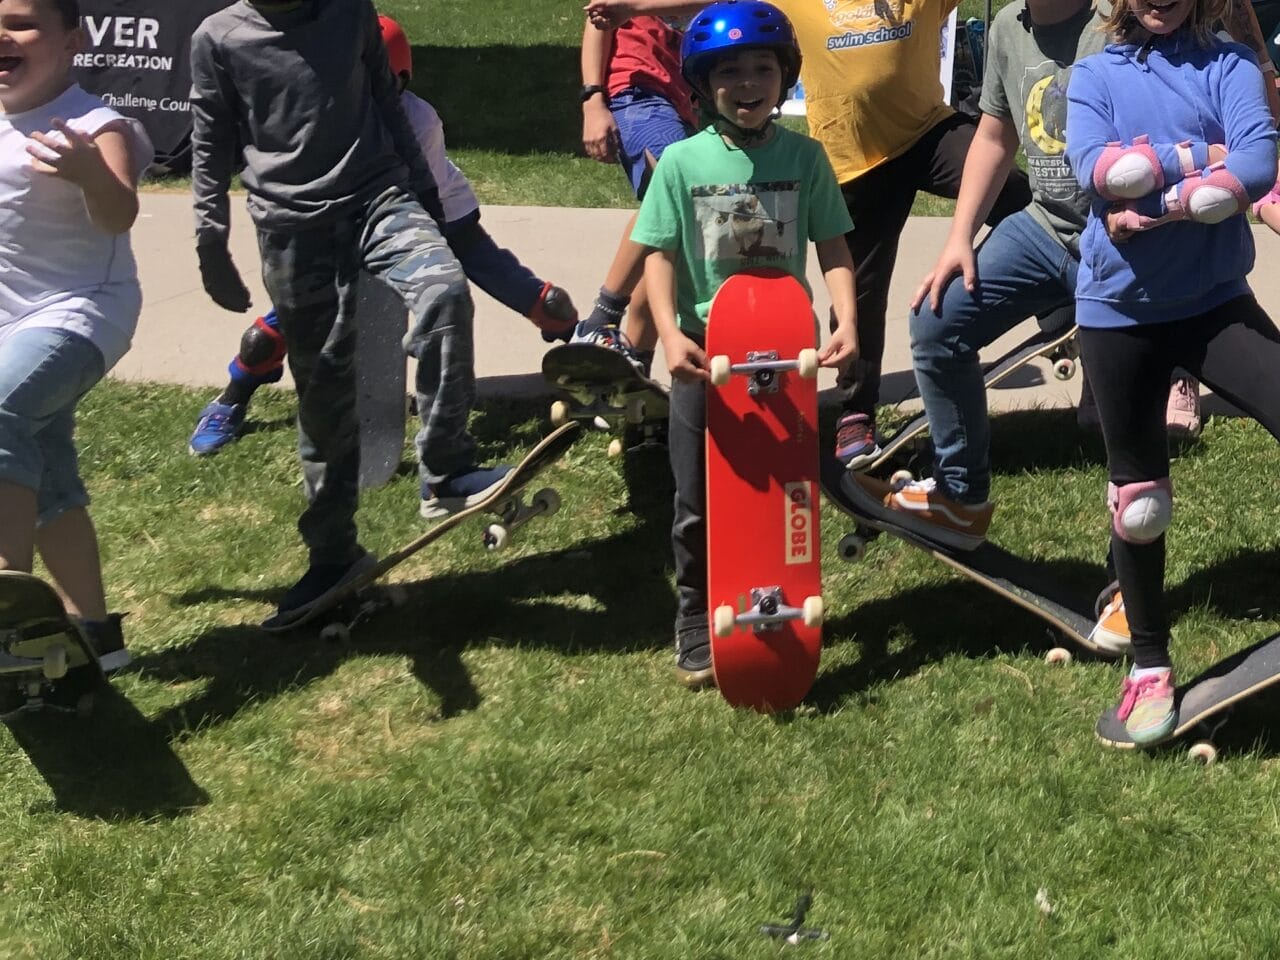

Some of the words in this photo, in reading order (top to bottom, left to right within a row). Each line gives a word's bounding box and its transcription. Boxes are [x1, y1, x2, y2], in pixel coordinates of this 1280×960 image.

[80, 16, 160, 49] VER
[828, 32, 863, 49] swim
[866, 21, 912, 43] school
[73, 53, 173, 71] RECREATION
[791, 487, 807, 557] GLOBE
